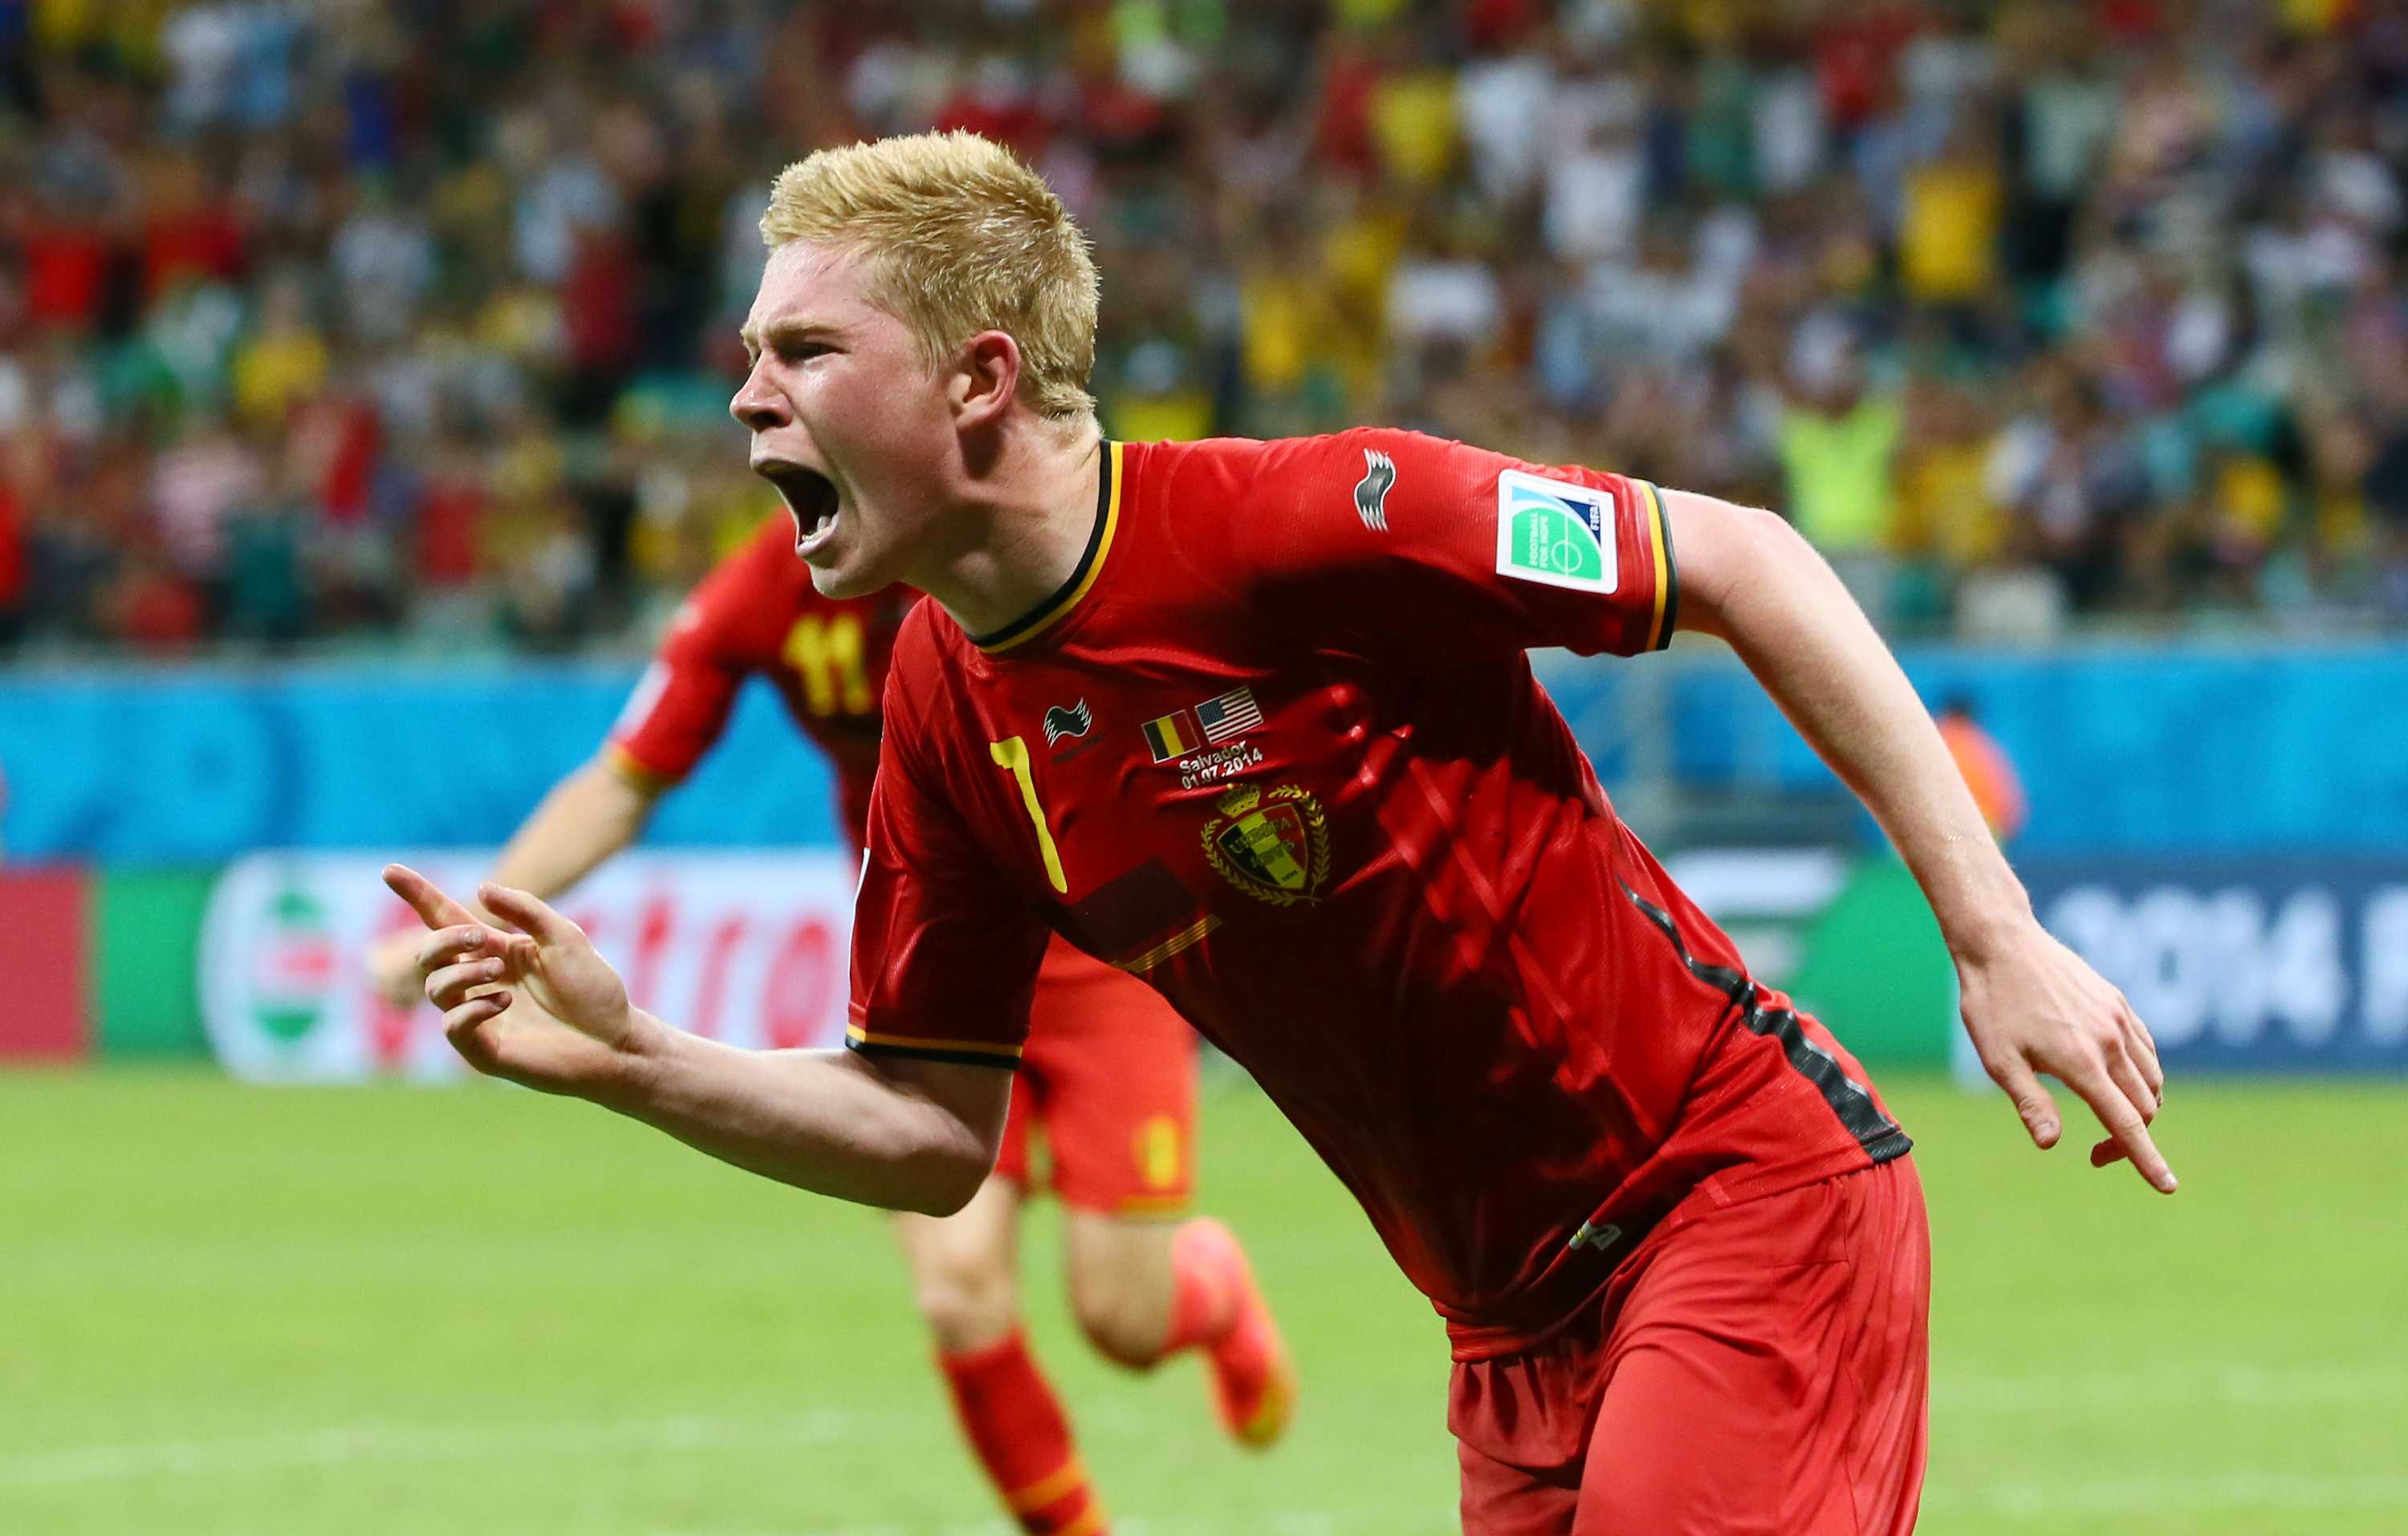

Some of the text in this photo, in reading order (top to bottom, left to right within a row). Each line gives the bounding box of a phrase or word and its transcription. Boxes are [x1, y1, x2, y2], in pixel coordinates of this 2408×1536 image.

[1528, 512, 1540, 567] FOOTBALL
[1539, 514, 1549, 568] FOR HOPE
[782, 613, 872, 717] 11
[1179, 740, 1247, 774] Salvador
